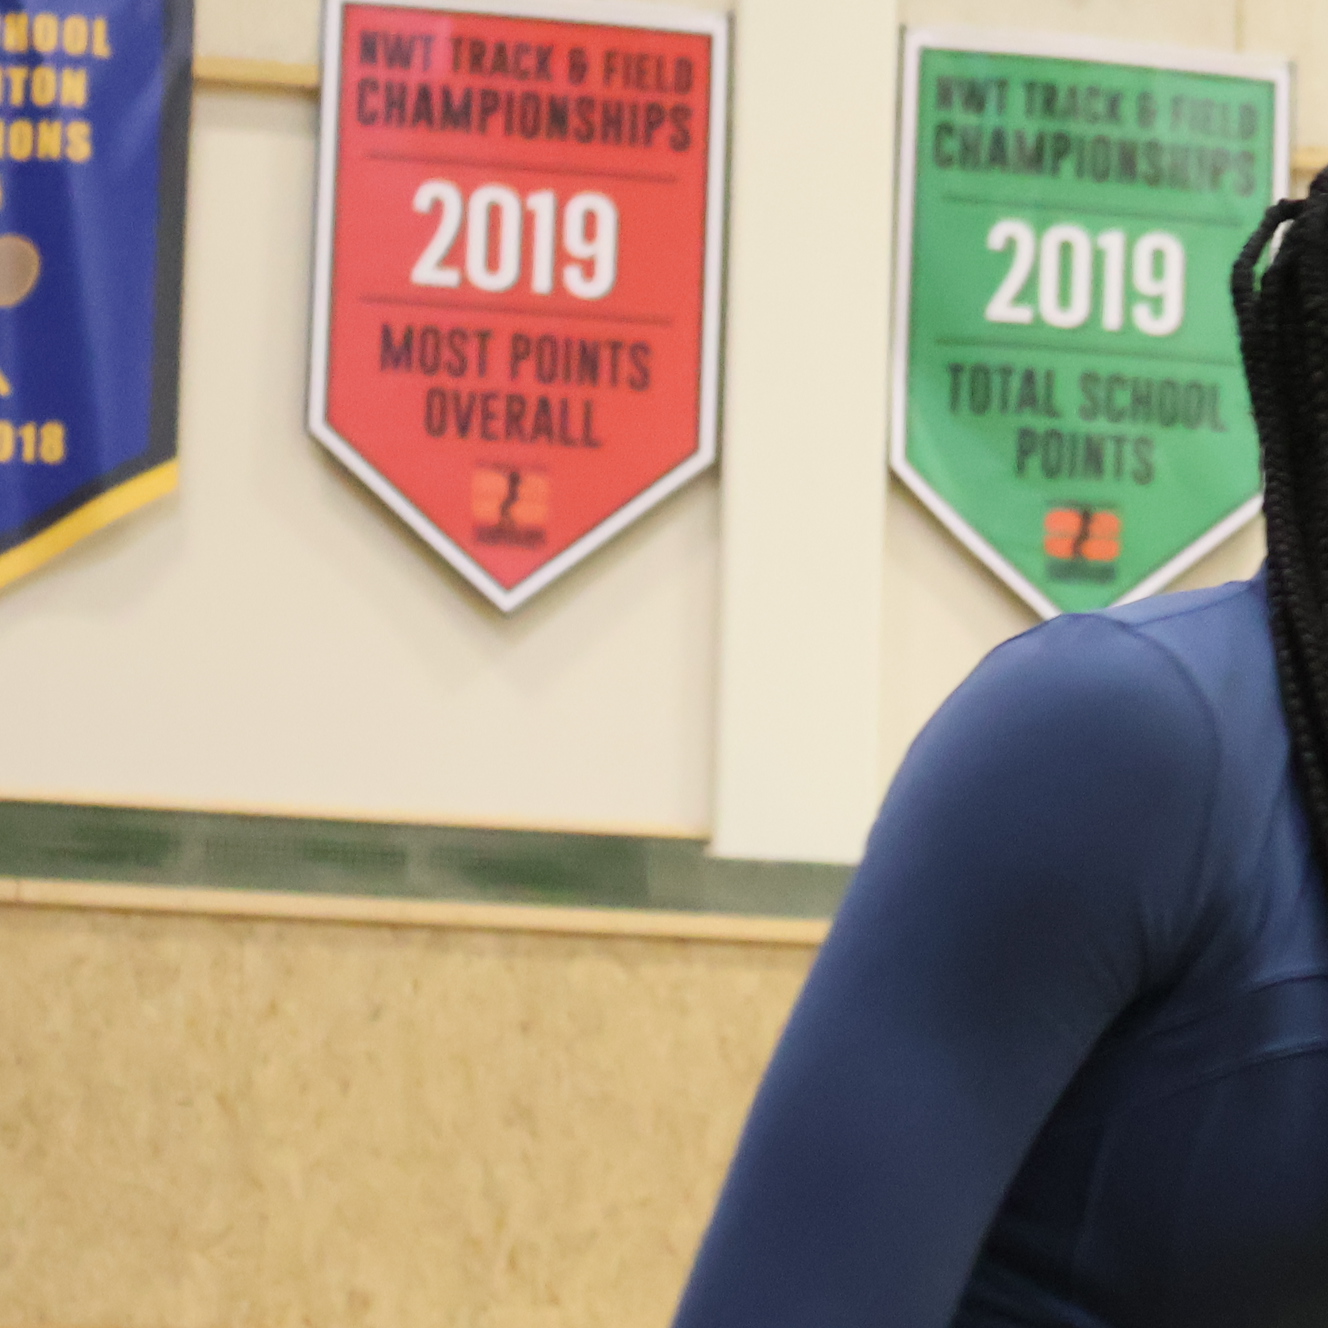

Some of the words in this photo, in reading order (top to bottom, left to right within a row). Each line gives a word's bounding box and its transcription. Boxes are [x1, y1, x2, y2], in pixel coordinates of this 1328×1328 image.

[359, 30, 435, 72] NWT
[453, 36, 555, 83] TRACK
[567, 47, 589, 87] &
[603, 51, 695, 96] FIELD
[356, 77, 694, 153] CHAMPIONSHIPS
[936, 75, 1009, 117] NWT
[1023, 80, 1123, 125] TRACK
[1168, 95, 1259, 140] FIELD
[933, 120, 1258, 198] CHAMPIONSHIPS
[410, 178, 620, 301] 2019
[984, 217, 1186, 337] 2019
[380, 323, 493, 379] MOST
[509, 333, 653, 392] POINTS
[424, 386, 603, 449] OVERALL
[946, 361, 1061, 419] TOTAL
[1077, 371, 1228, 432] SCHOOL
[1014, 426, 1155, 486] POINTS
